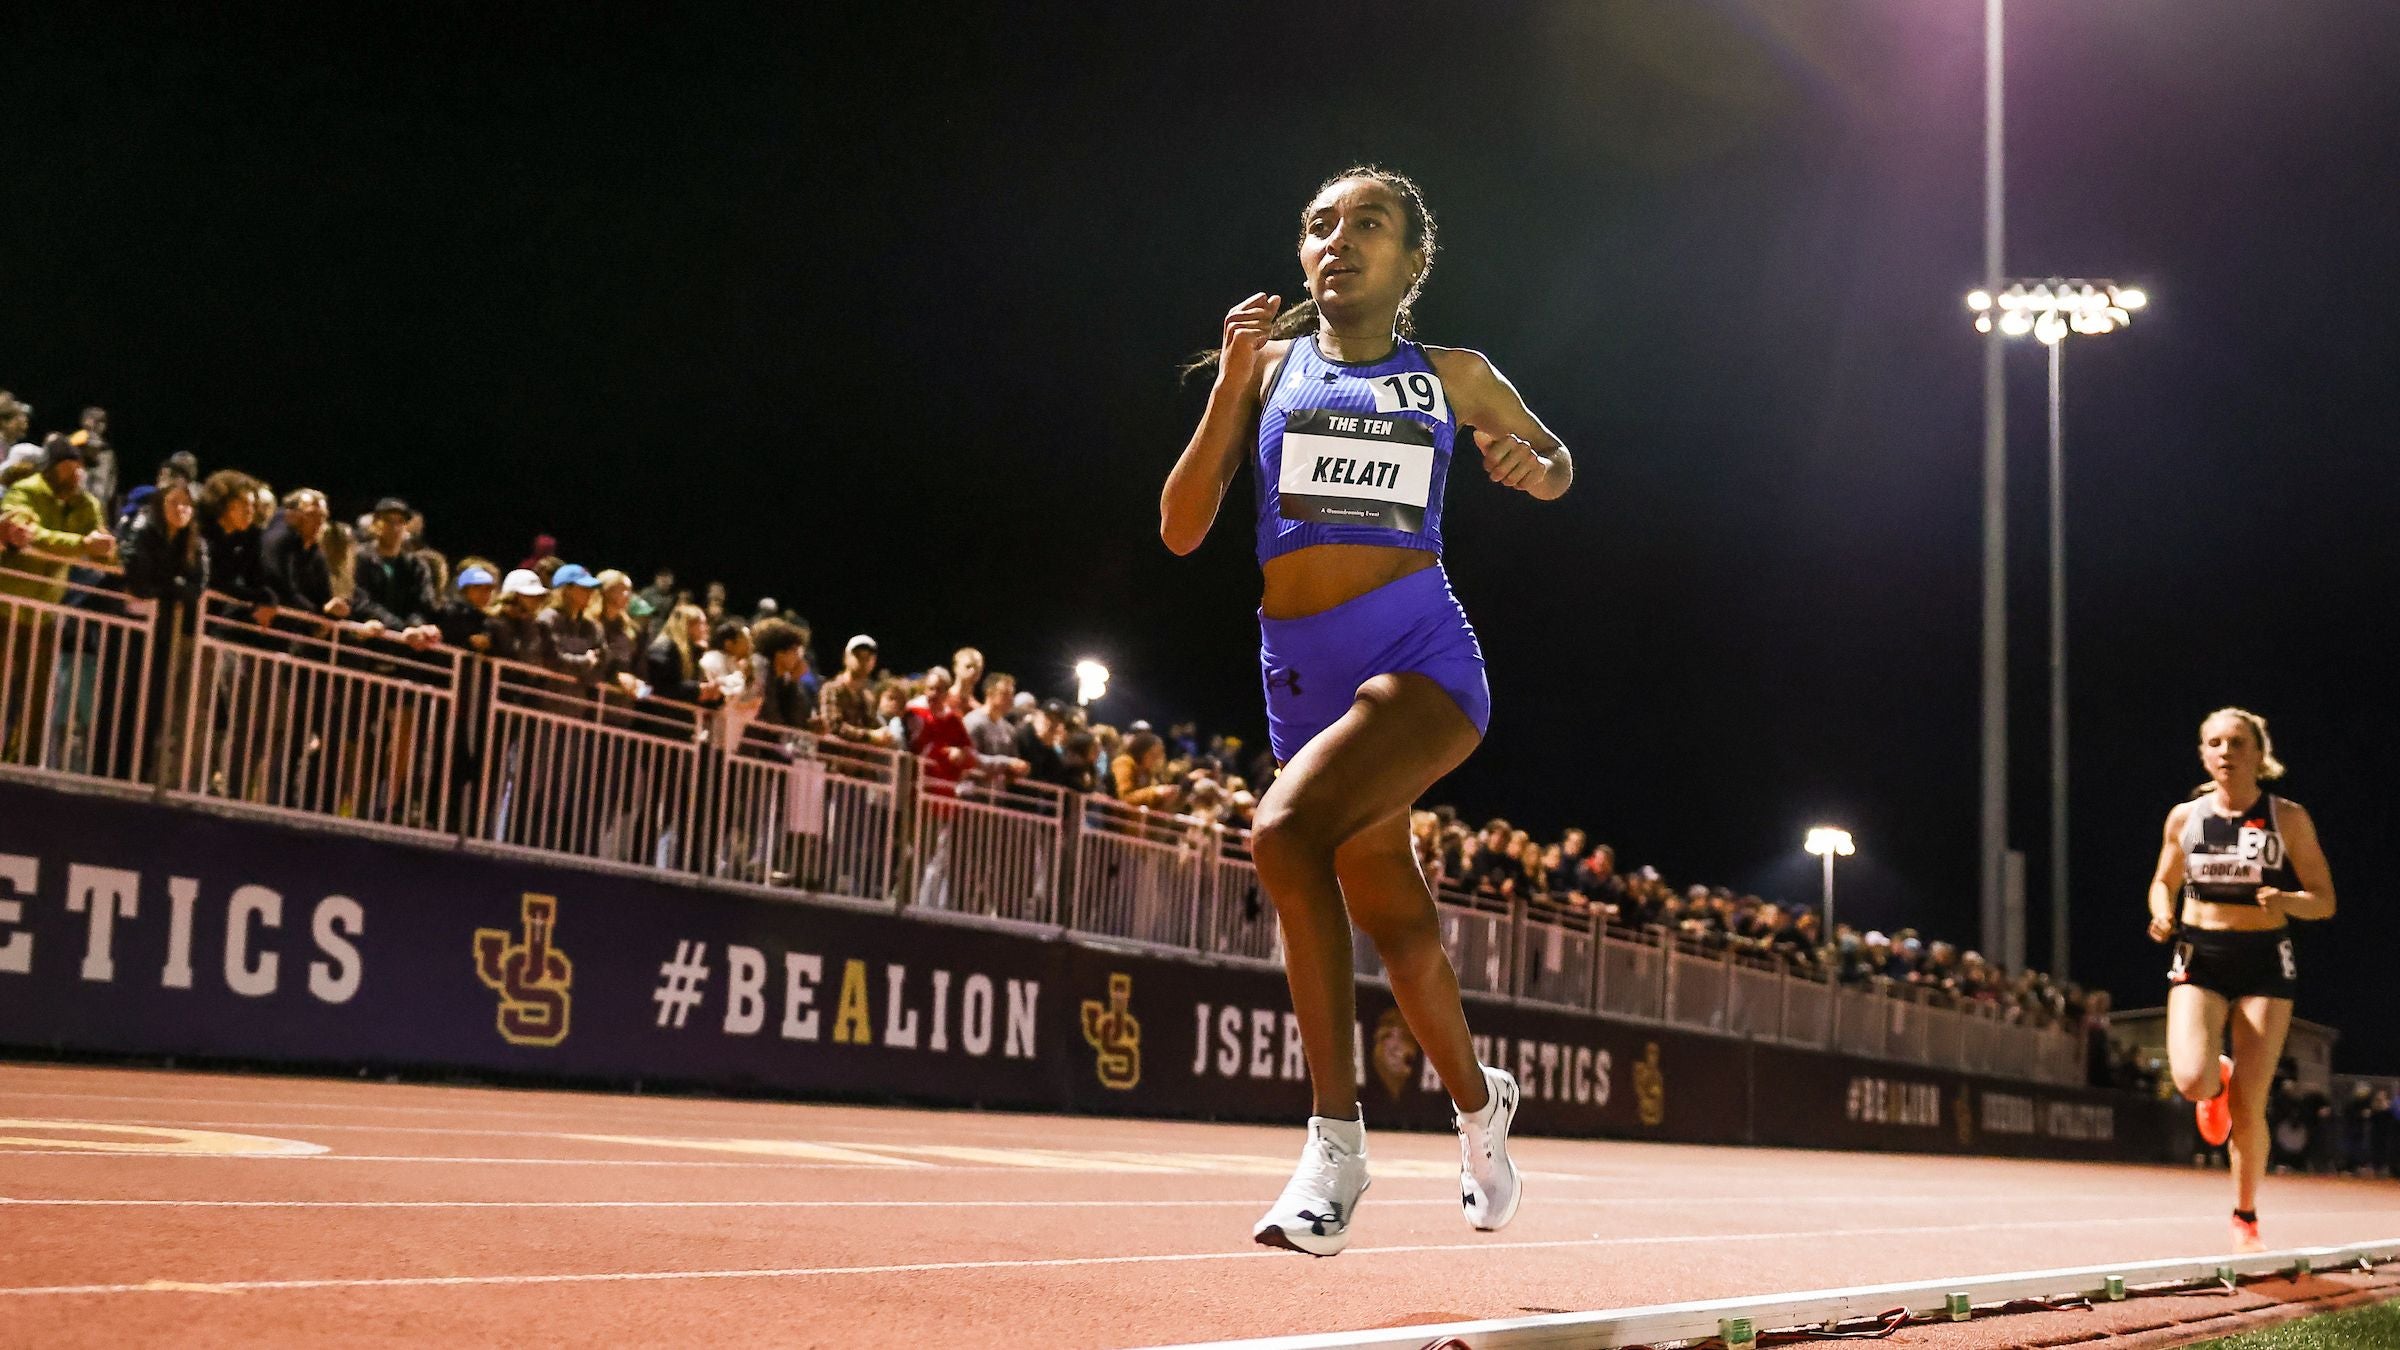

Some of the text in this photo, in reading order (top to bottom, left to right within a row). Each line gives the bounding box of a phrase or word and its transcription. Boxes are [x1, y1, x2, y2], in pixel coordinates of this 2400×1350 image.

[1383, 373, 1436, 412] 19
[1328, 415, 1393, 436] THE TEN
[1311, 456, 1401, 490] KELATI
[652, 939, 1041, 1060] #BEALION
[1192, 1002, 1612, 1107] JSER AETICS
